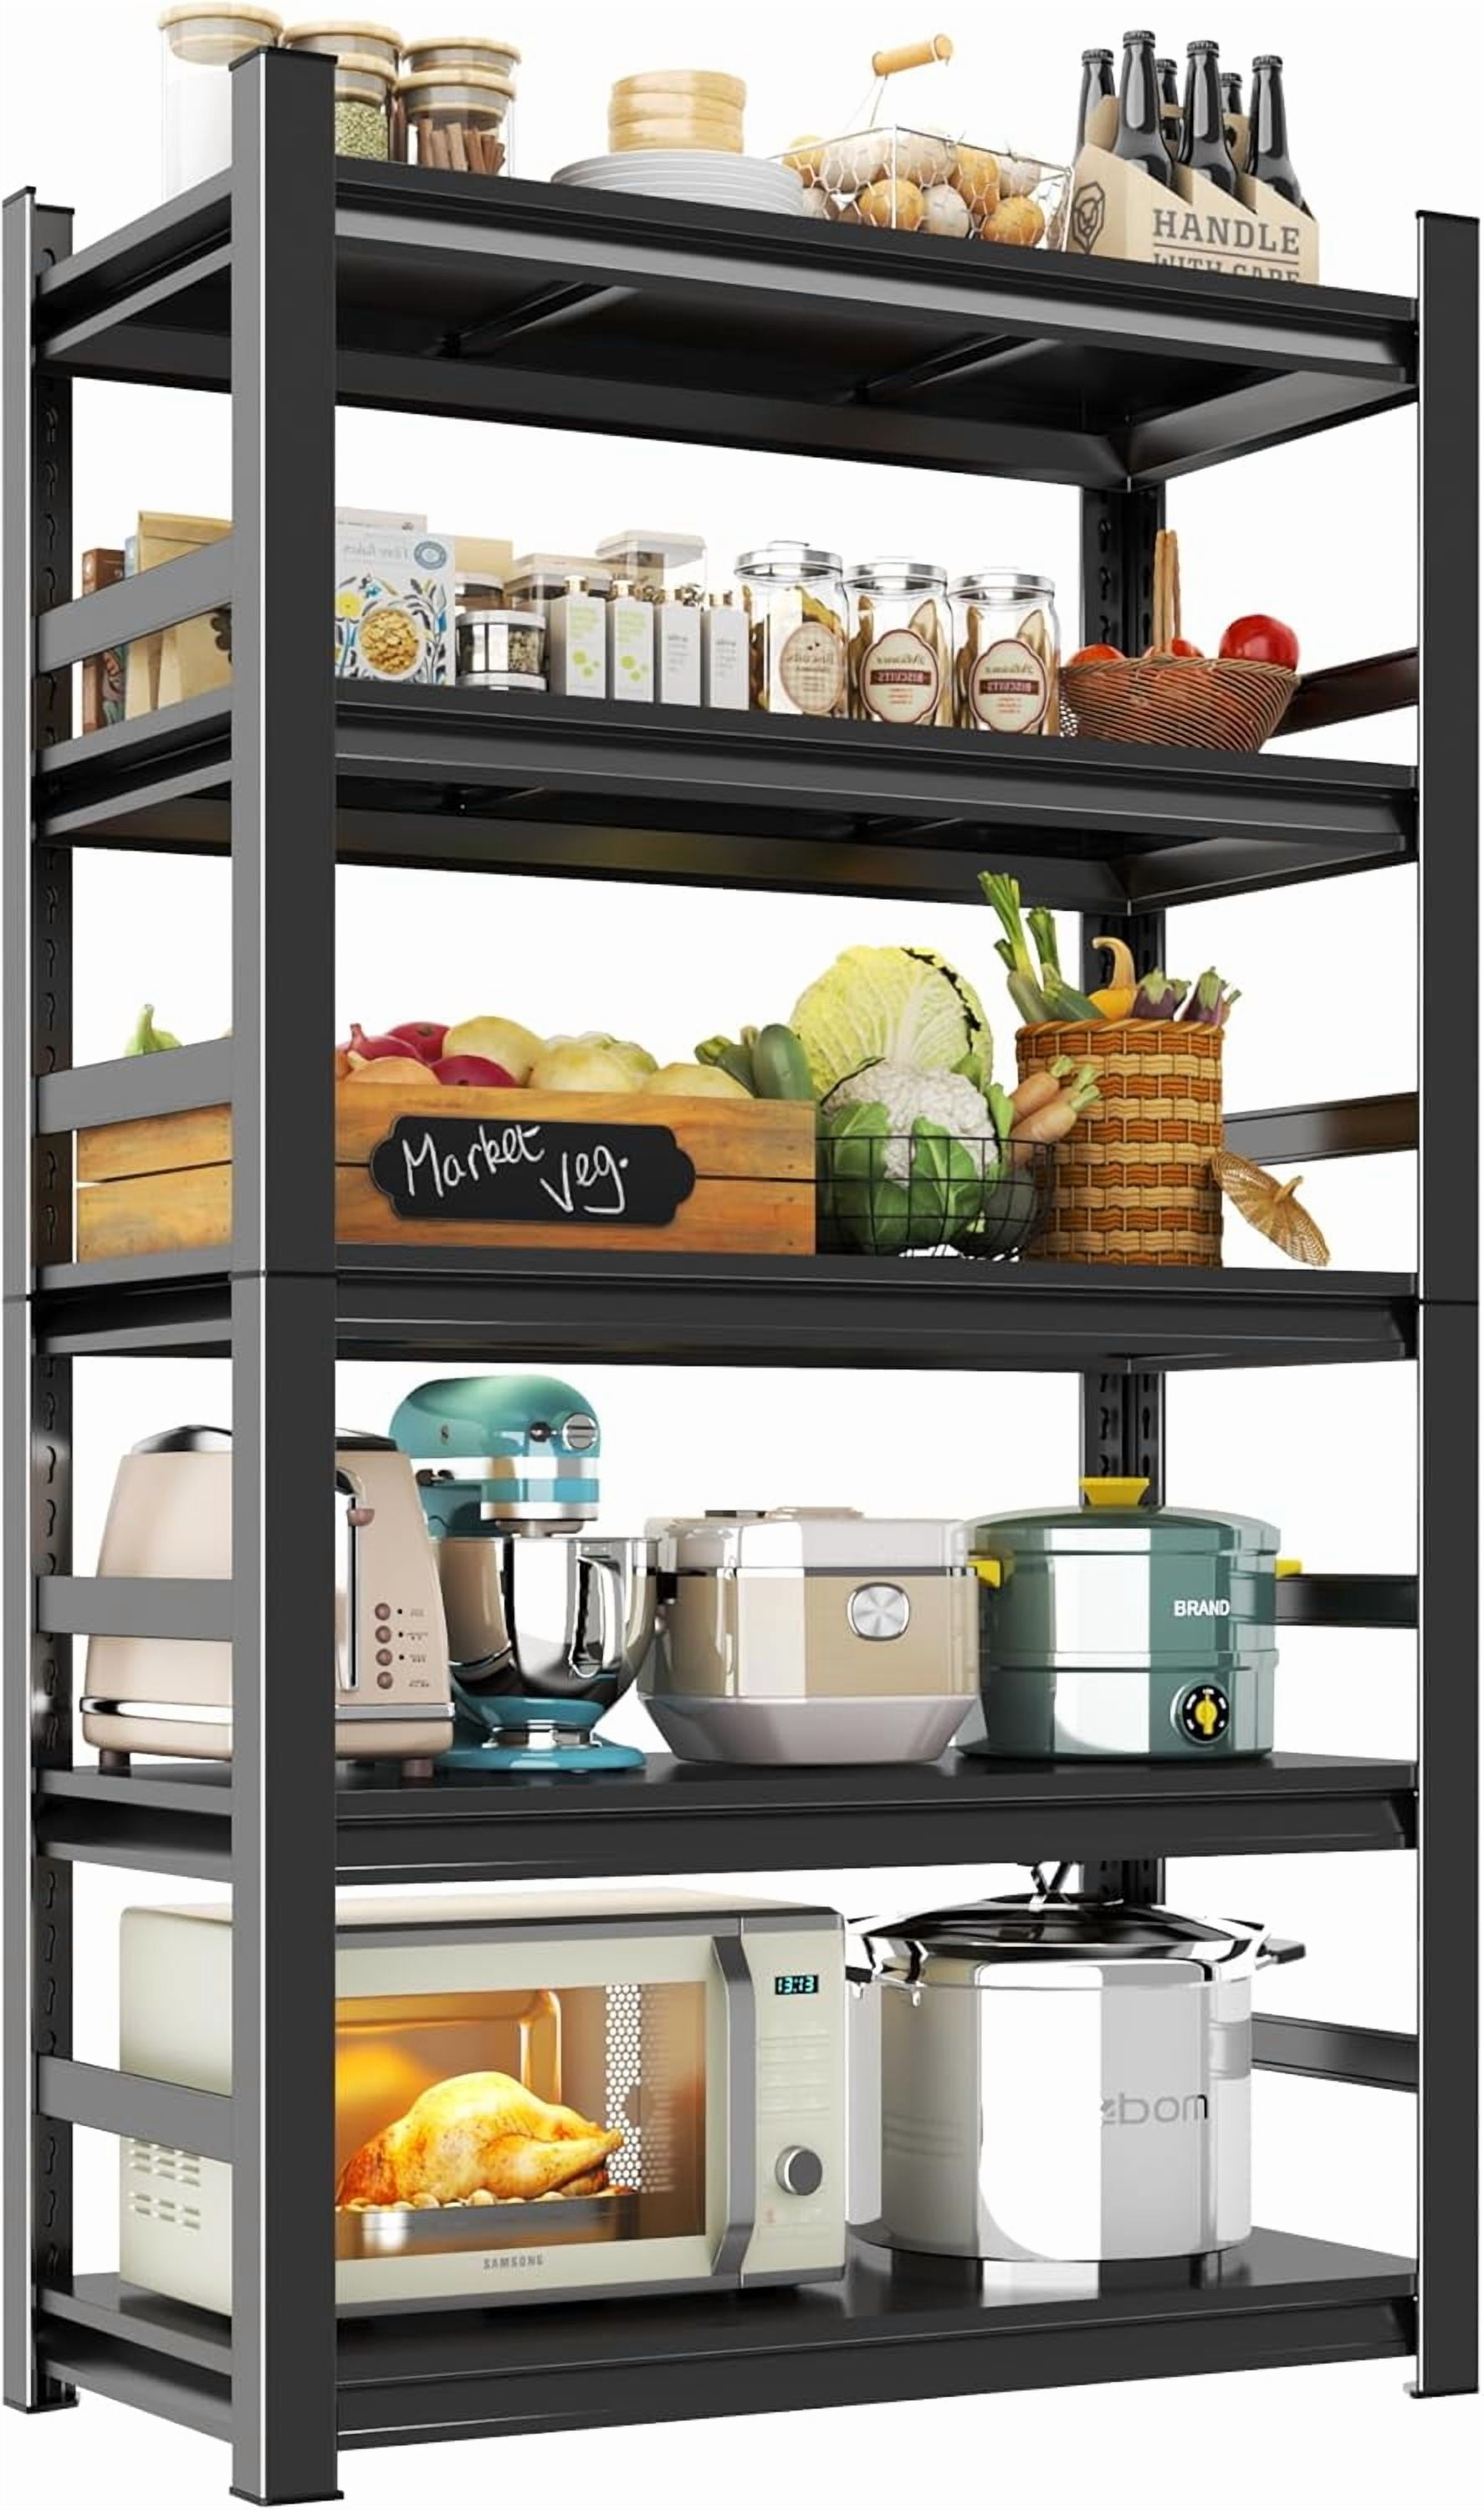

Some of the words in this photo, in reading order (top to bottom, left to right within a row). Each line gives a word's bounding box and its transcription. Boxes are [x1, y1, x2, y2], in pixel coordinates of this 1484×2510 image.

[1153, 209, 1299, 256] HANDLE
[402, 1124, 545, 1197] Market
[1174, 1599, 1231, 1616] BRAND
[777, 1976, 815, 1993] 13:13
